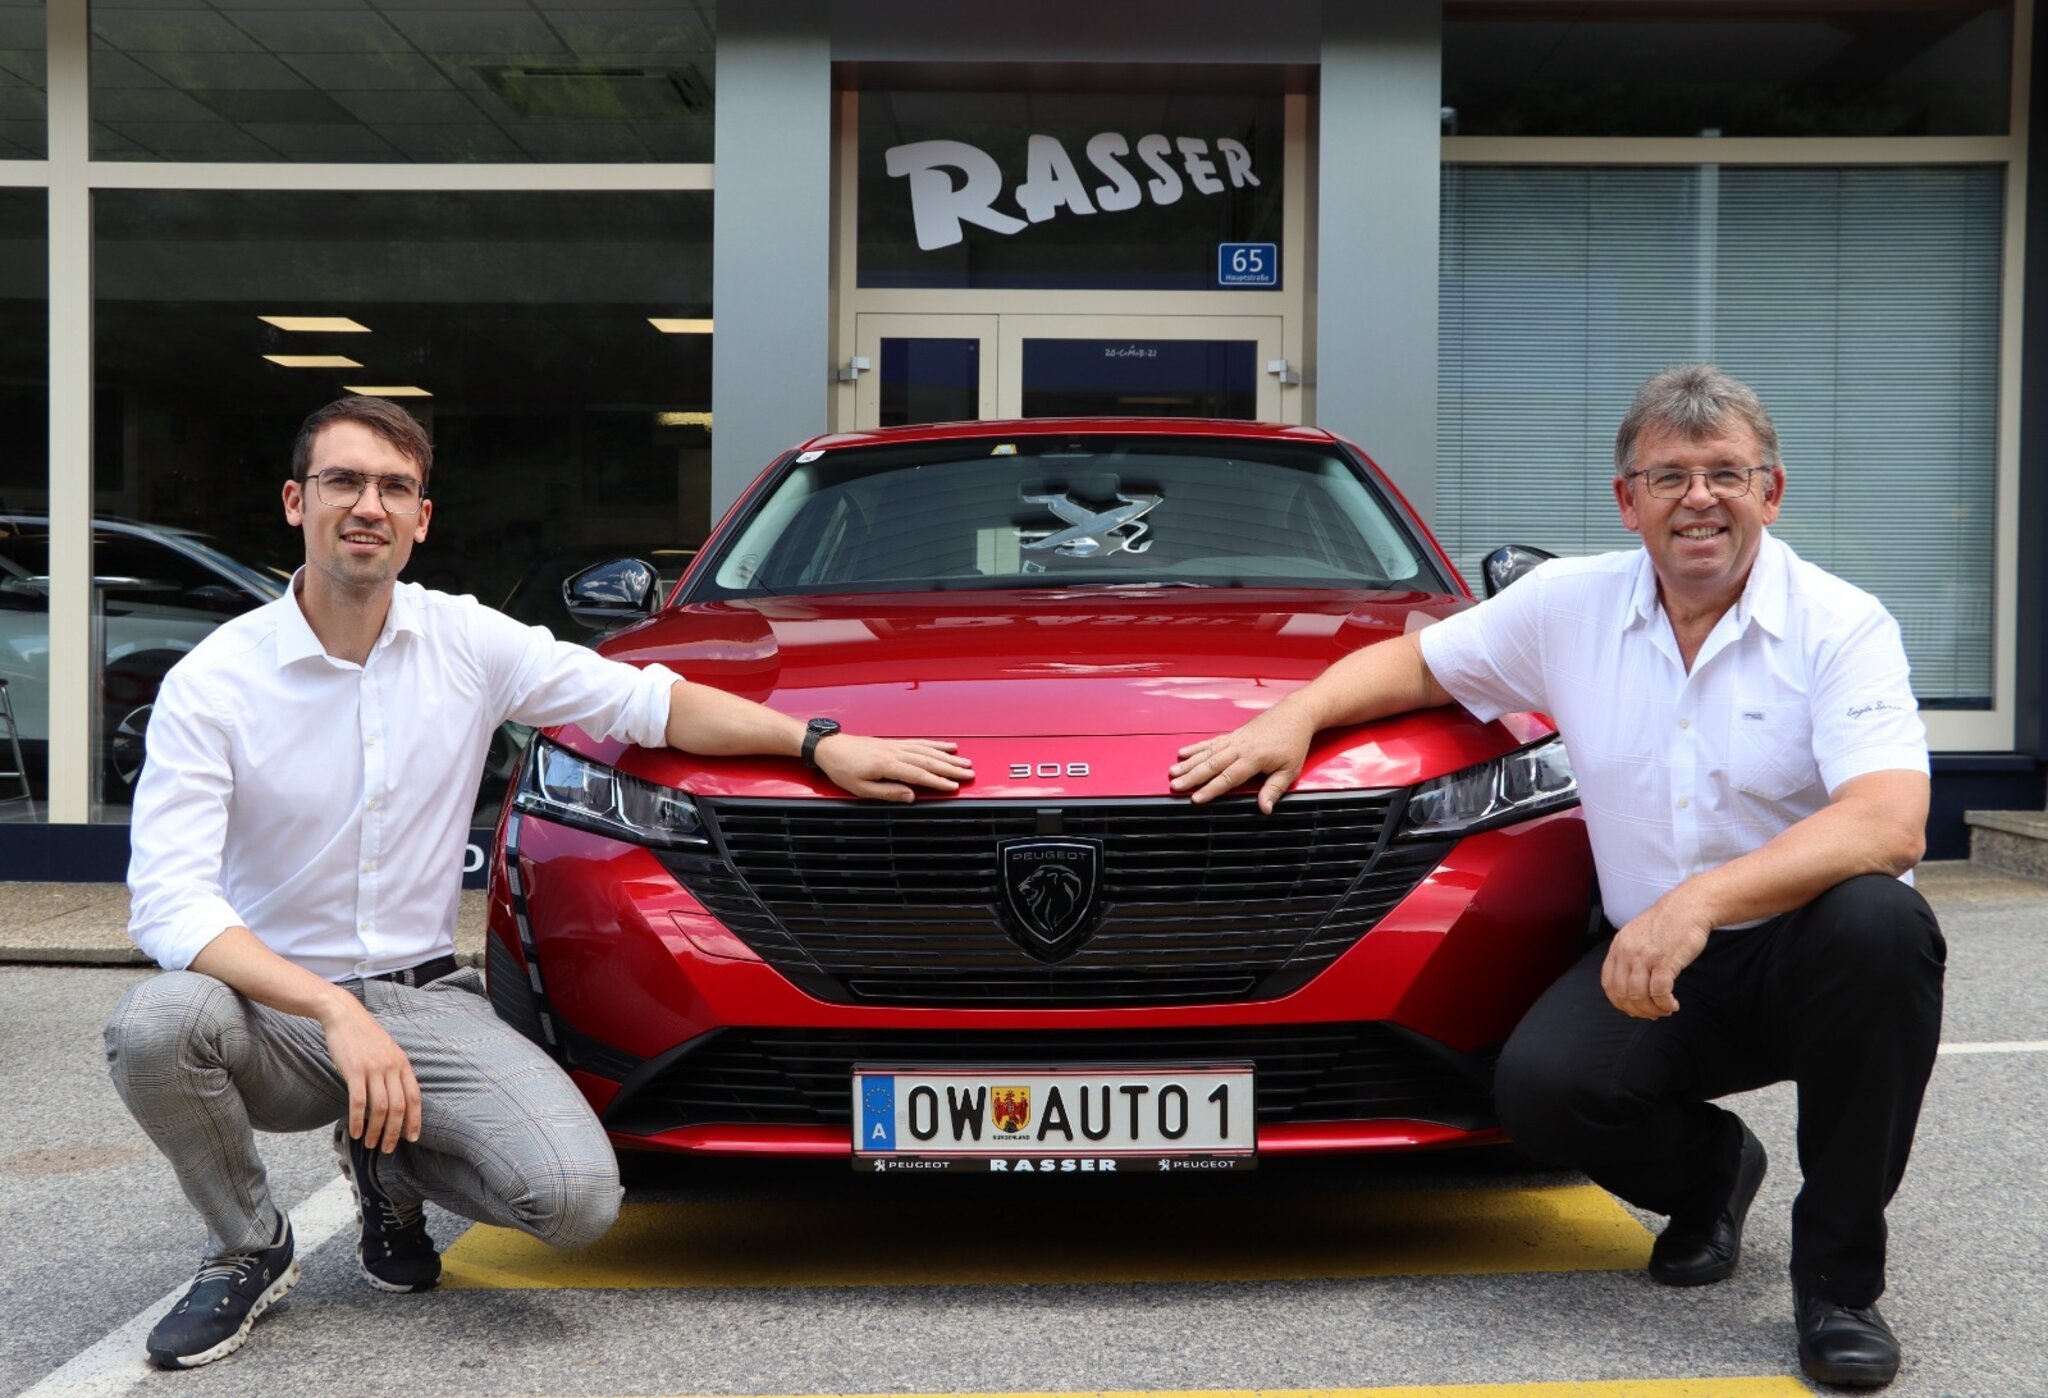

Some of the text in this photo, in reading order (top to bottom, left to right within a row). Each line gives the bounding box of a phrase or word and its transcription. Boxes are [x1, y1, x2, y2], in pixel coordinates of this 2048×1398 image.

[885, 132, 1261, 251] RASSER
[1232, 248, 1263, 273] 65
[1225, 273, 1270, 282] Hauptstraße
[1009, 762, 1090, 778] 308
[1012, 850, 1088, 861] PEUGEOT
[908, 1082, 1230, 1142] OW AUTO 1
[871, 1122, 887, 1140] A
[888, 1160, 951, 1169] PEUGEOT
[989, 1158, 1118, 1172] RASSER
[1173, 1160, 1236, 1169] PEUGEOT
